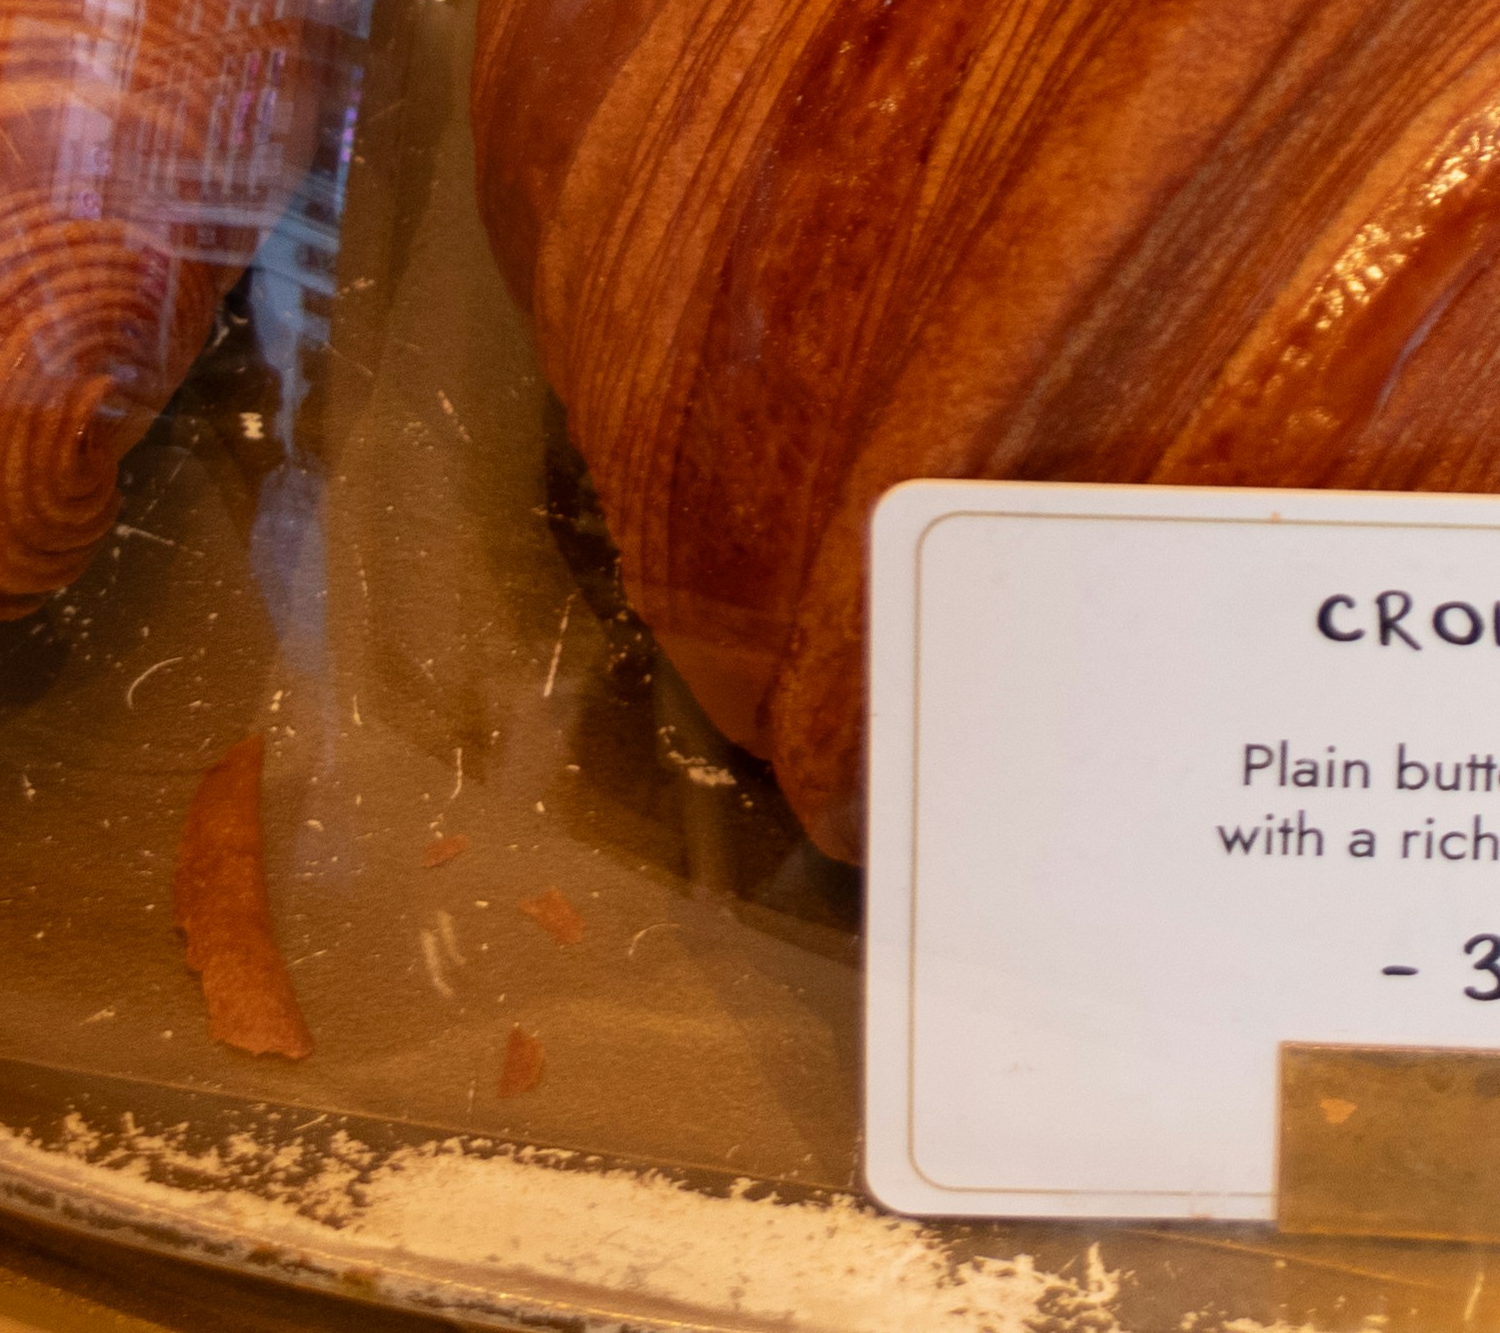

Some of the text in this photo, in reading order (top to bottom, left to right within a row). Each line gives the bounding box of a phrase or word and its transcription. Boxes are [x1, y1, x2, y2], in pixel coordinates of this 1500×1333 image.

[1242, 740, 1371, 790] Plain
[1216, 809, 1325, 858] with
[1347, 828, 1377, 859] a
[1400, 814, 1500, 862] rich
